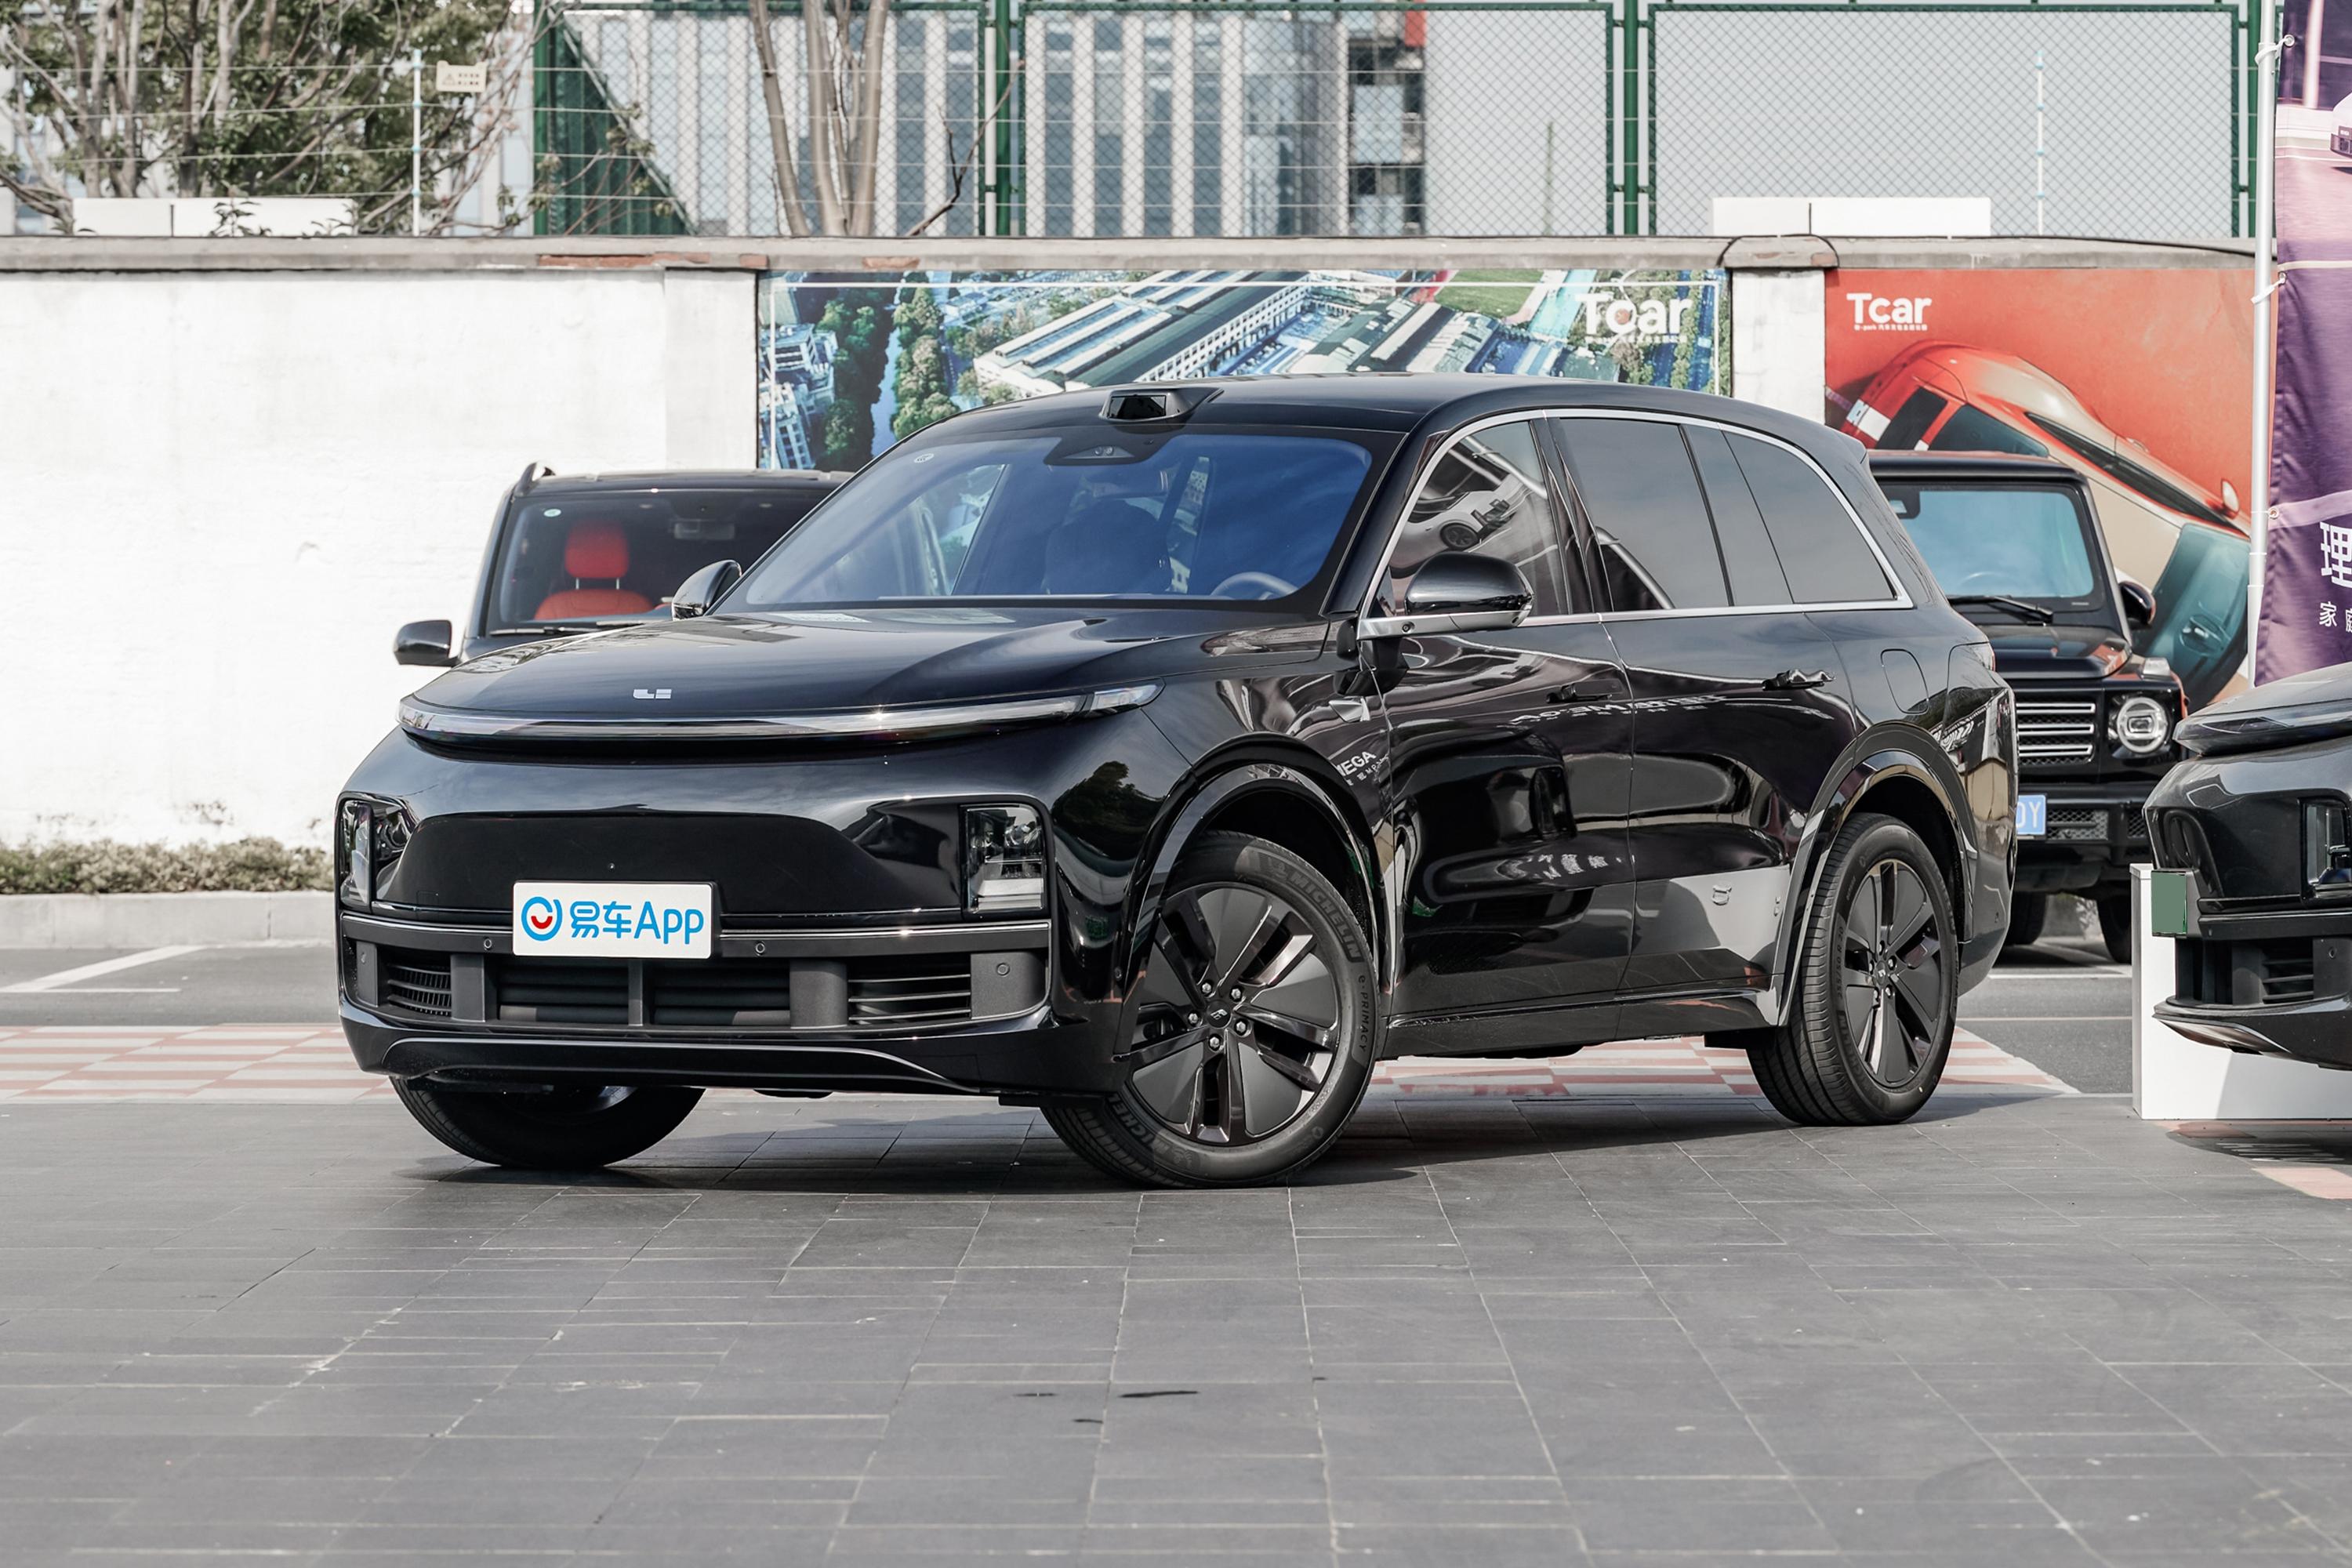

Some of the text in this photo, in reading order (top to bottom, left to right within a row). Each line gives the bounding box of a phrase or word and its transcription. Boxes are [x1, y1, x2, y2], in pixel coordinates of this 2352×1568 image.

[1846, 292, 1933, 324] Tcar
[569, 900, 705, 945] 易车App
[1288, 872, 1363, 960] MICHELIN
